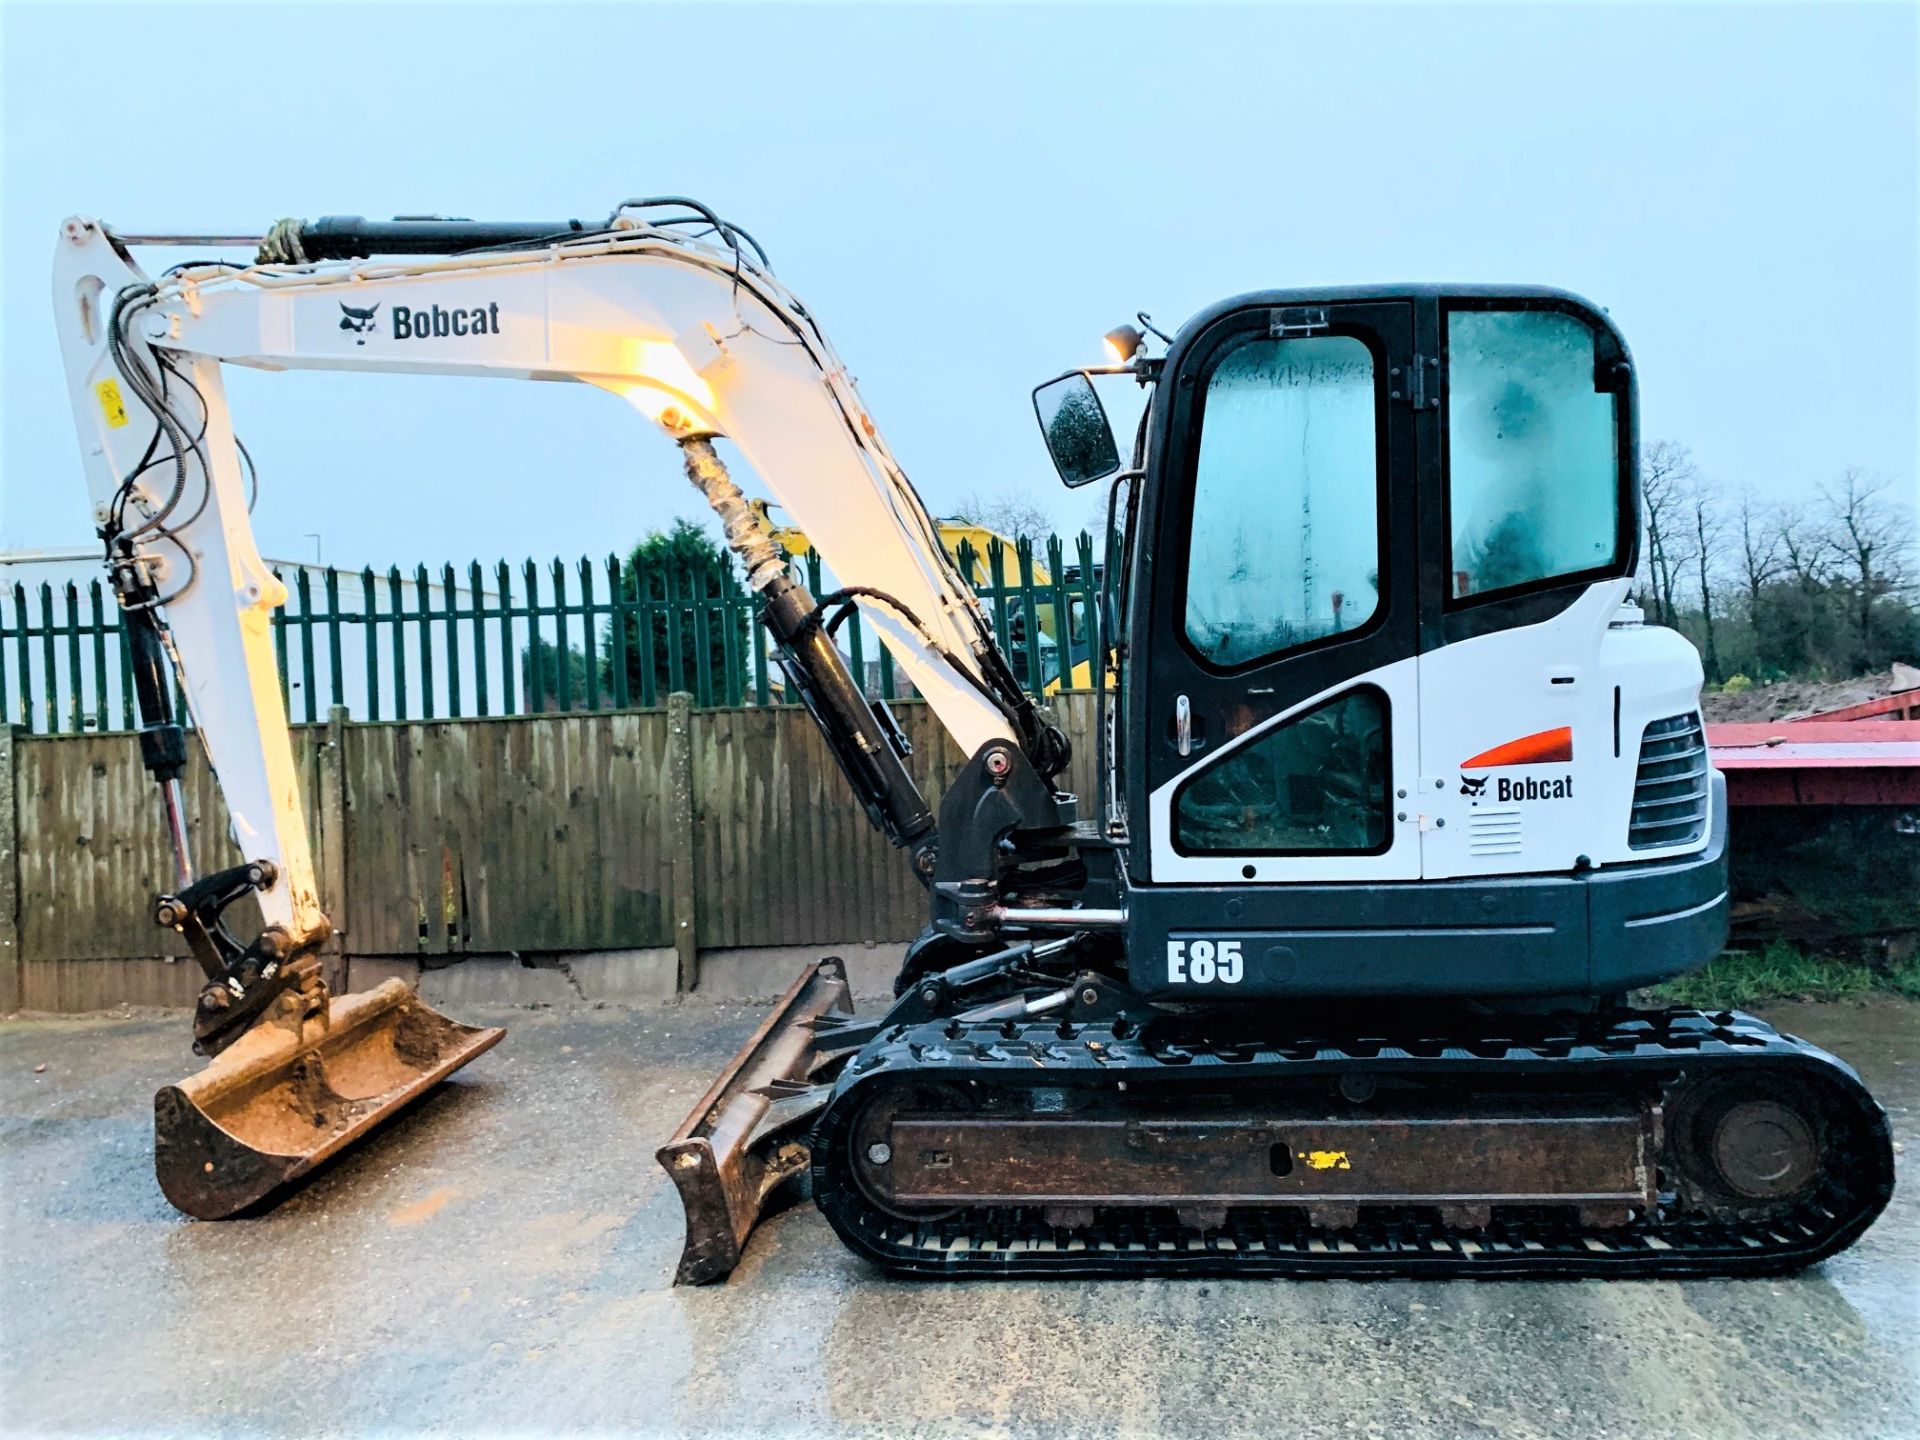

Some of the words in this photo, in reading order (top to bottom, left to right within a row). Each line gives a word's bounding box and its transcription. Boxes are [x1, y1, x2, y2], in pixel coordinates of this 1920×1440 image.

[392, 302, 500, 340] Bobcat
[1498, 775, 1573, 802] Bobcat
[1167, 940, 1244, 984] E85
